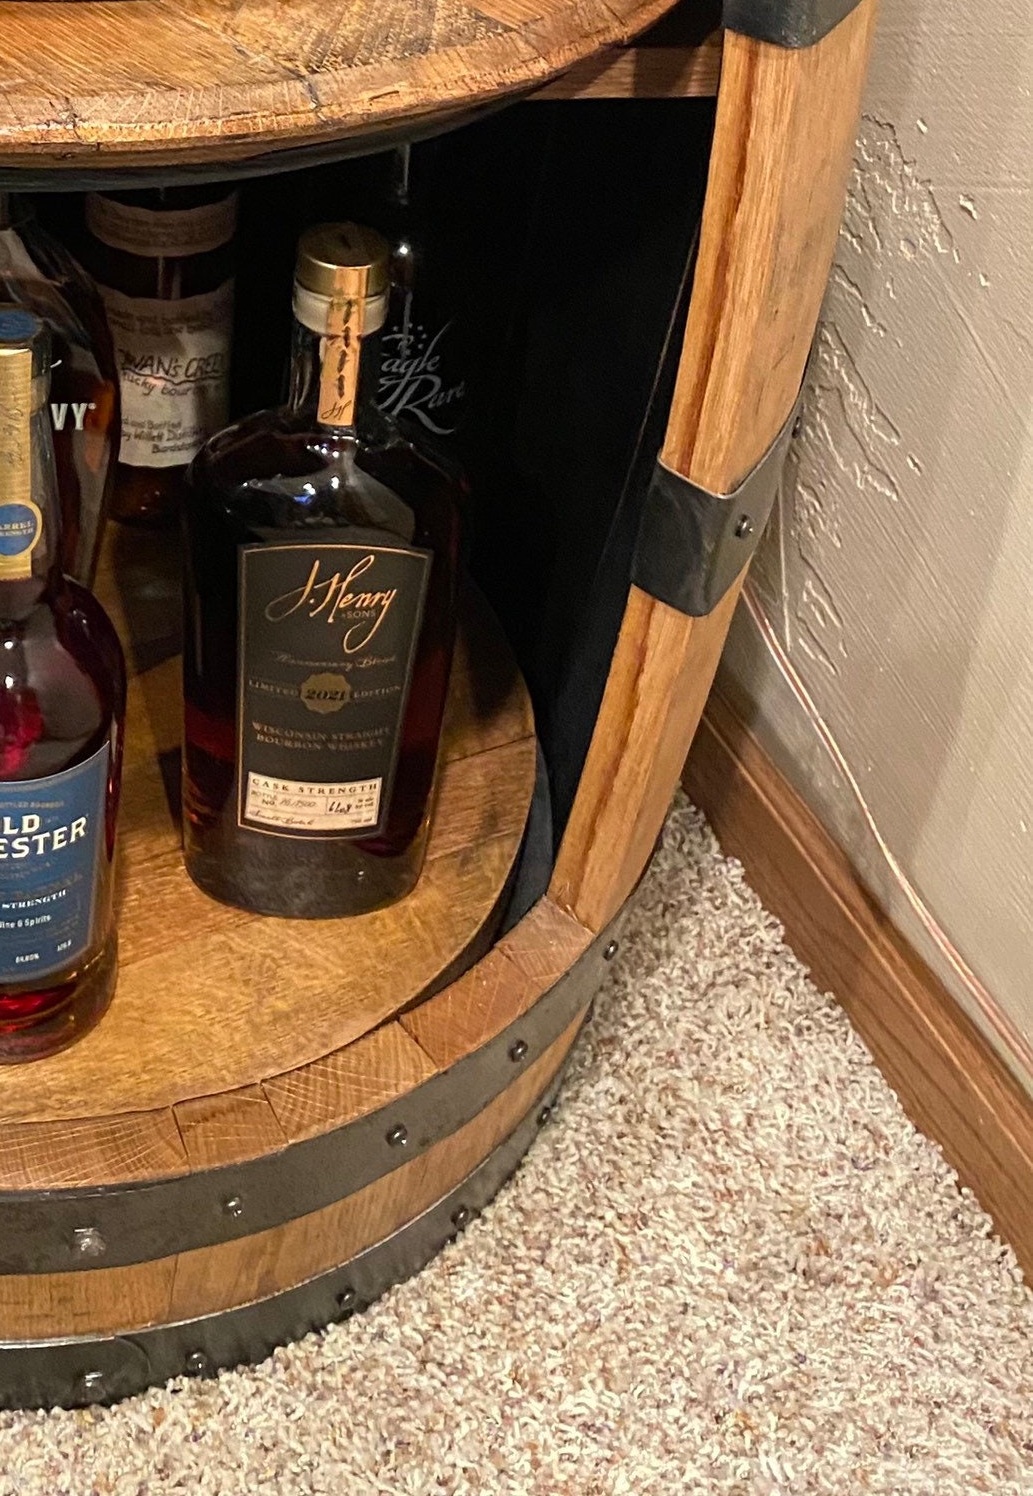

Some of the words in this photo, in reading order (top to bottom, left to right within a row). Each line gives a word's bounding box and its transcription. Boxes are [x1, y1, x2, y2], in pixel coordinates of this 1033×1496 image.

[346, 609, 377, 620] SONS
[248, 678, 298, 696] LIMITED
[305, 688, 347, 701] 2021
[353, 684, 402, 699] EDITION
[251, 720, 328, 742] WISCONSIN
[256, 733, 322, 750] BOURBON
[326, 738, 384, 751] WHISKEY
[252, 778, 290, 792] CASK
[298, 782, 378, 794] STRENGTH
[1, 888, 67, 910] STRENGTH
